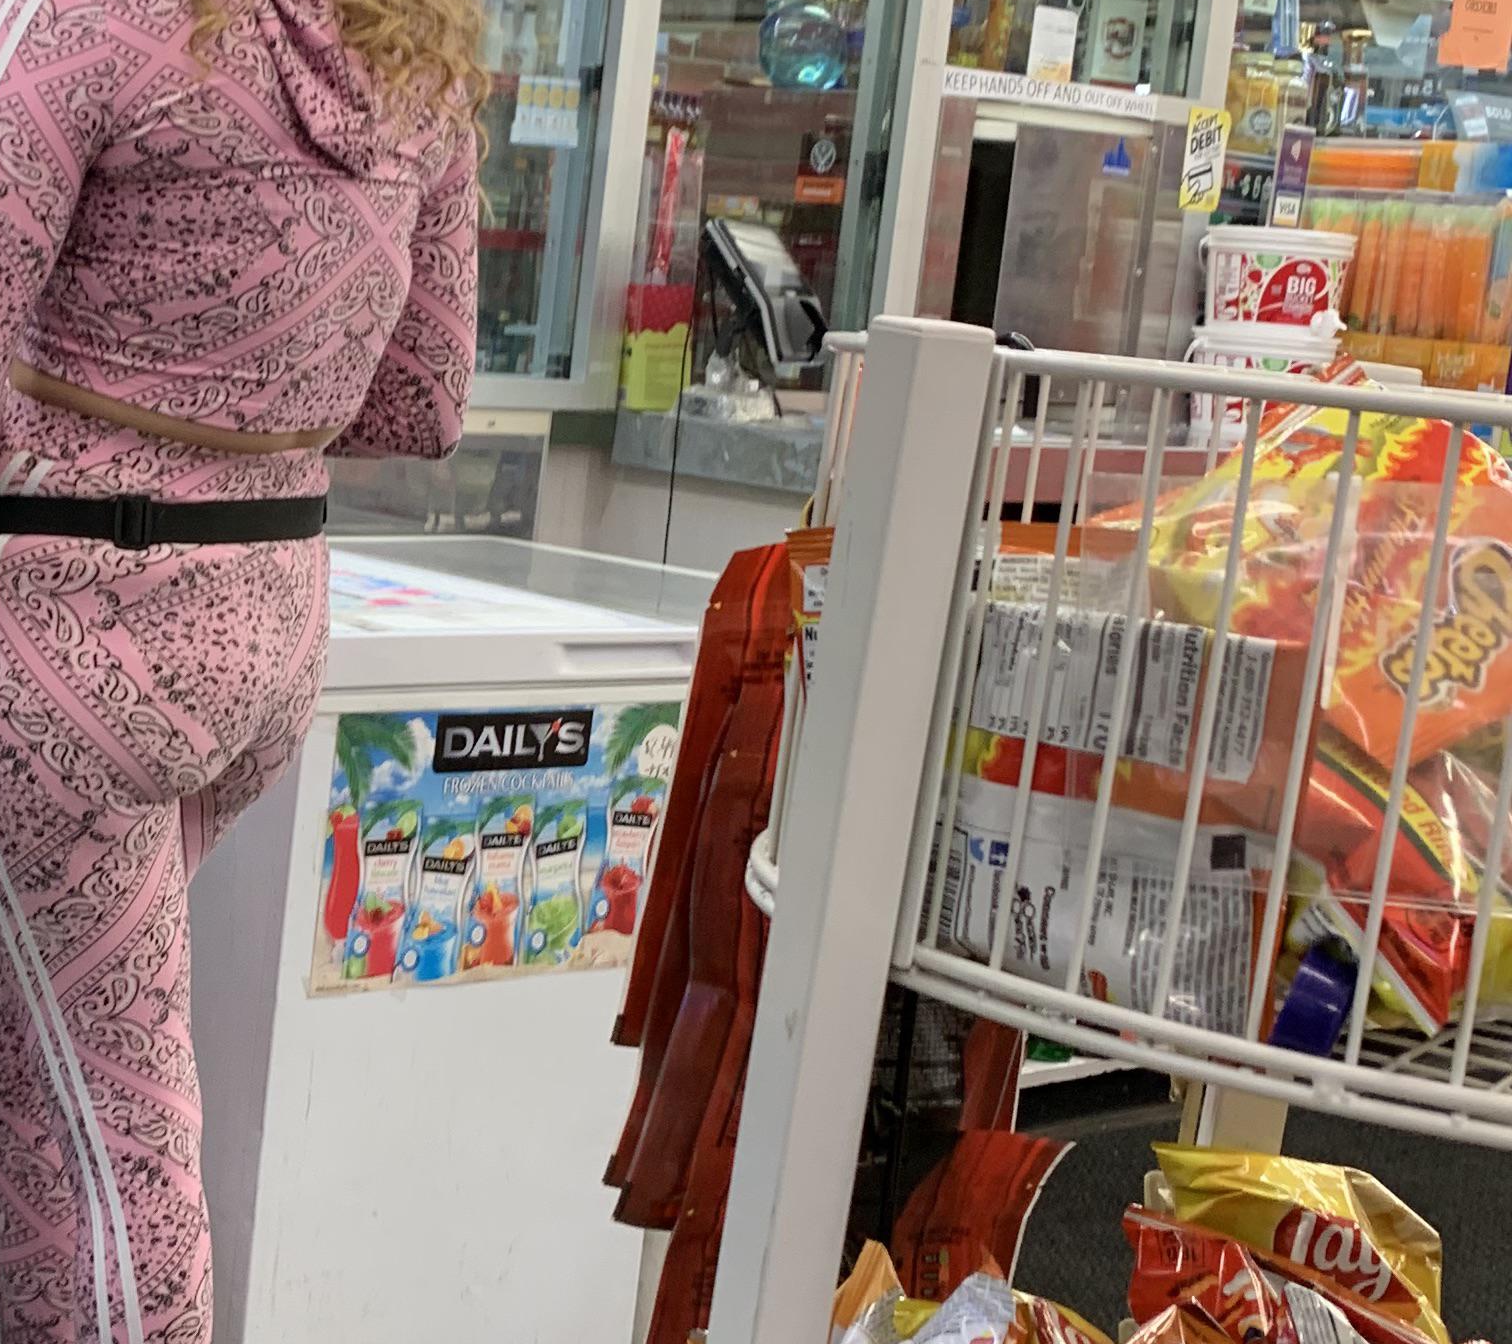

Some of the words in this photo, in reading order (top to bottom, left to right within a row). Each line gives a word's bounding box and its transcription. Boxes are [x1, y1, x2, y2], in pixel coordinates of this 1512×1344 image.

[944, 70, 978, 91] KEEP
[978, 74, 1025, 96] HANDS
[1026, 80, 1050, 100] OFF
[1053, 85, 1081, 104] AND
[1085, 91, 1105, 106] OUT
[1106, 95, 1125, 110] OFF
[1192, 114, 1220, 133] ACCEPT
[1190, 127, 1224, 155] DEBIT
[1287, 275, 1317, 295] BIG
[1105, 615, 1128, 677] alories
[443, 717, 587, 763] DAILY'S
[443, 774, 499, 796] FROZEN
